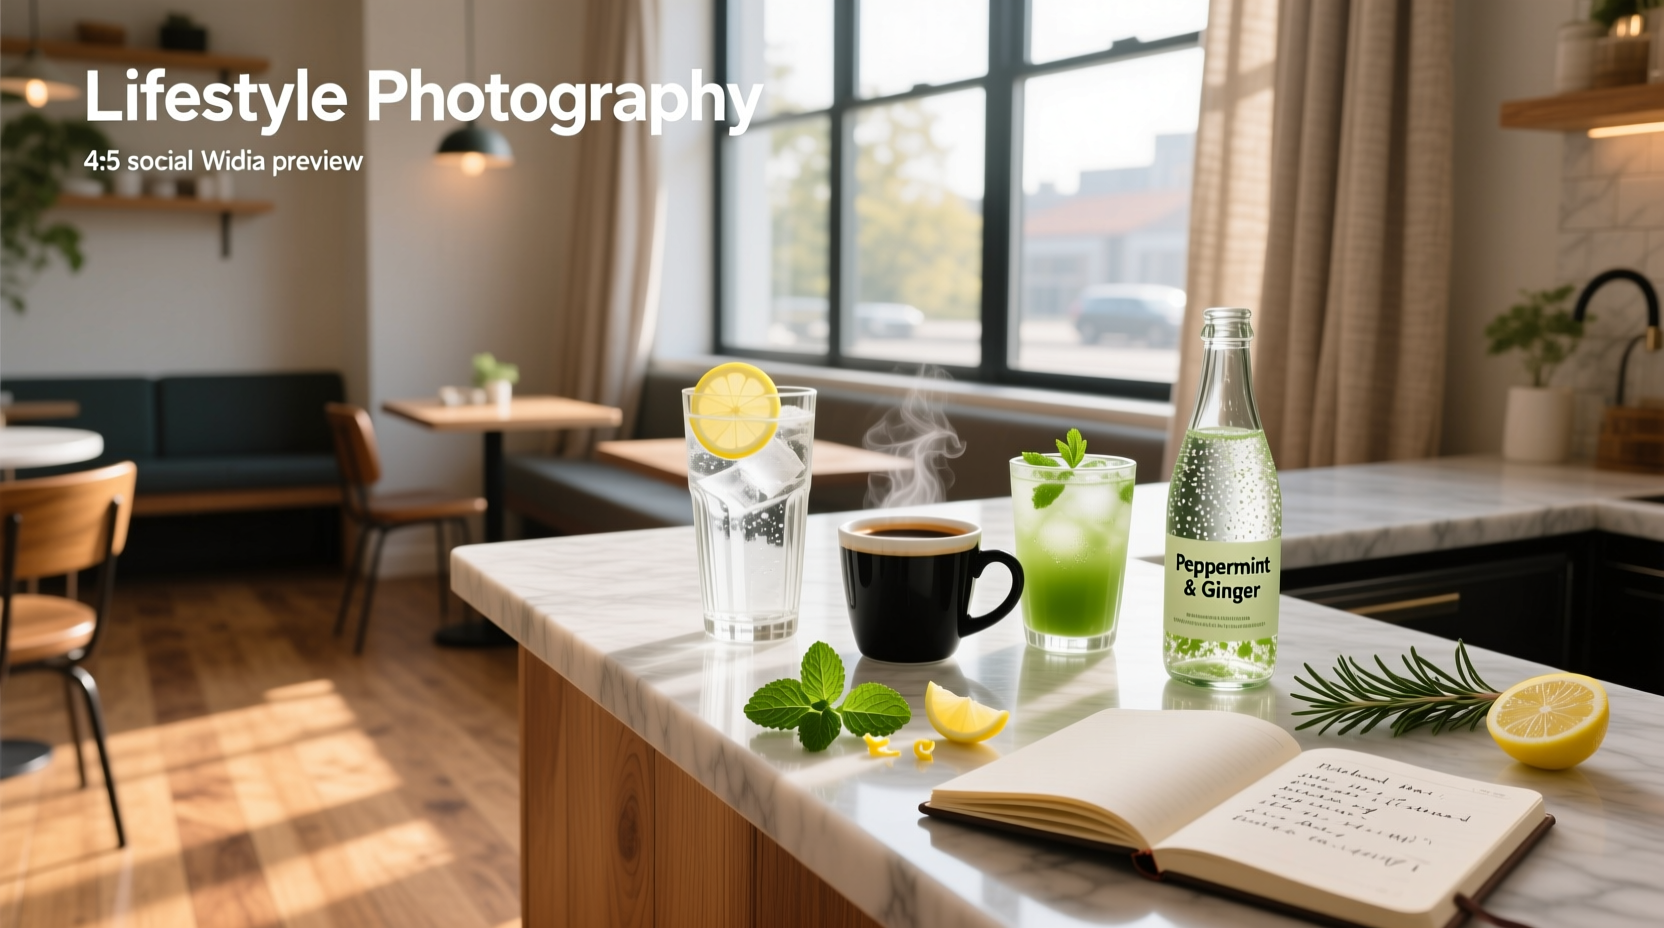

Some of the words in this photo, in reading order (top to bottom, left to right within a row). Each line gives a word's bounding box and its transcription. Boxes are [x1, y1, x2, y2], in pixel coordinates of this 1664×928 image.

[1176, 553, 1271, 578] Peppermint
[1184, 579, 1196, 597] &
[1201, 580, 1261, 604] Ginger
